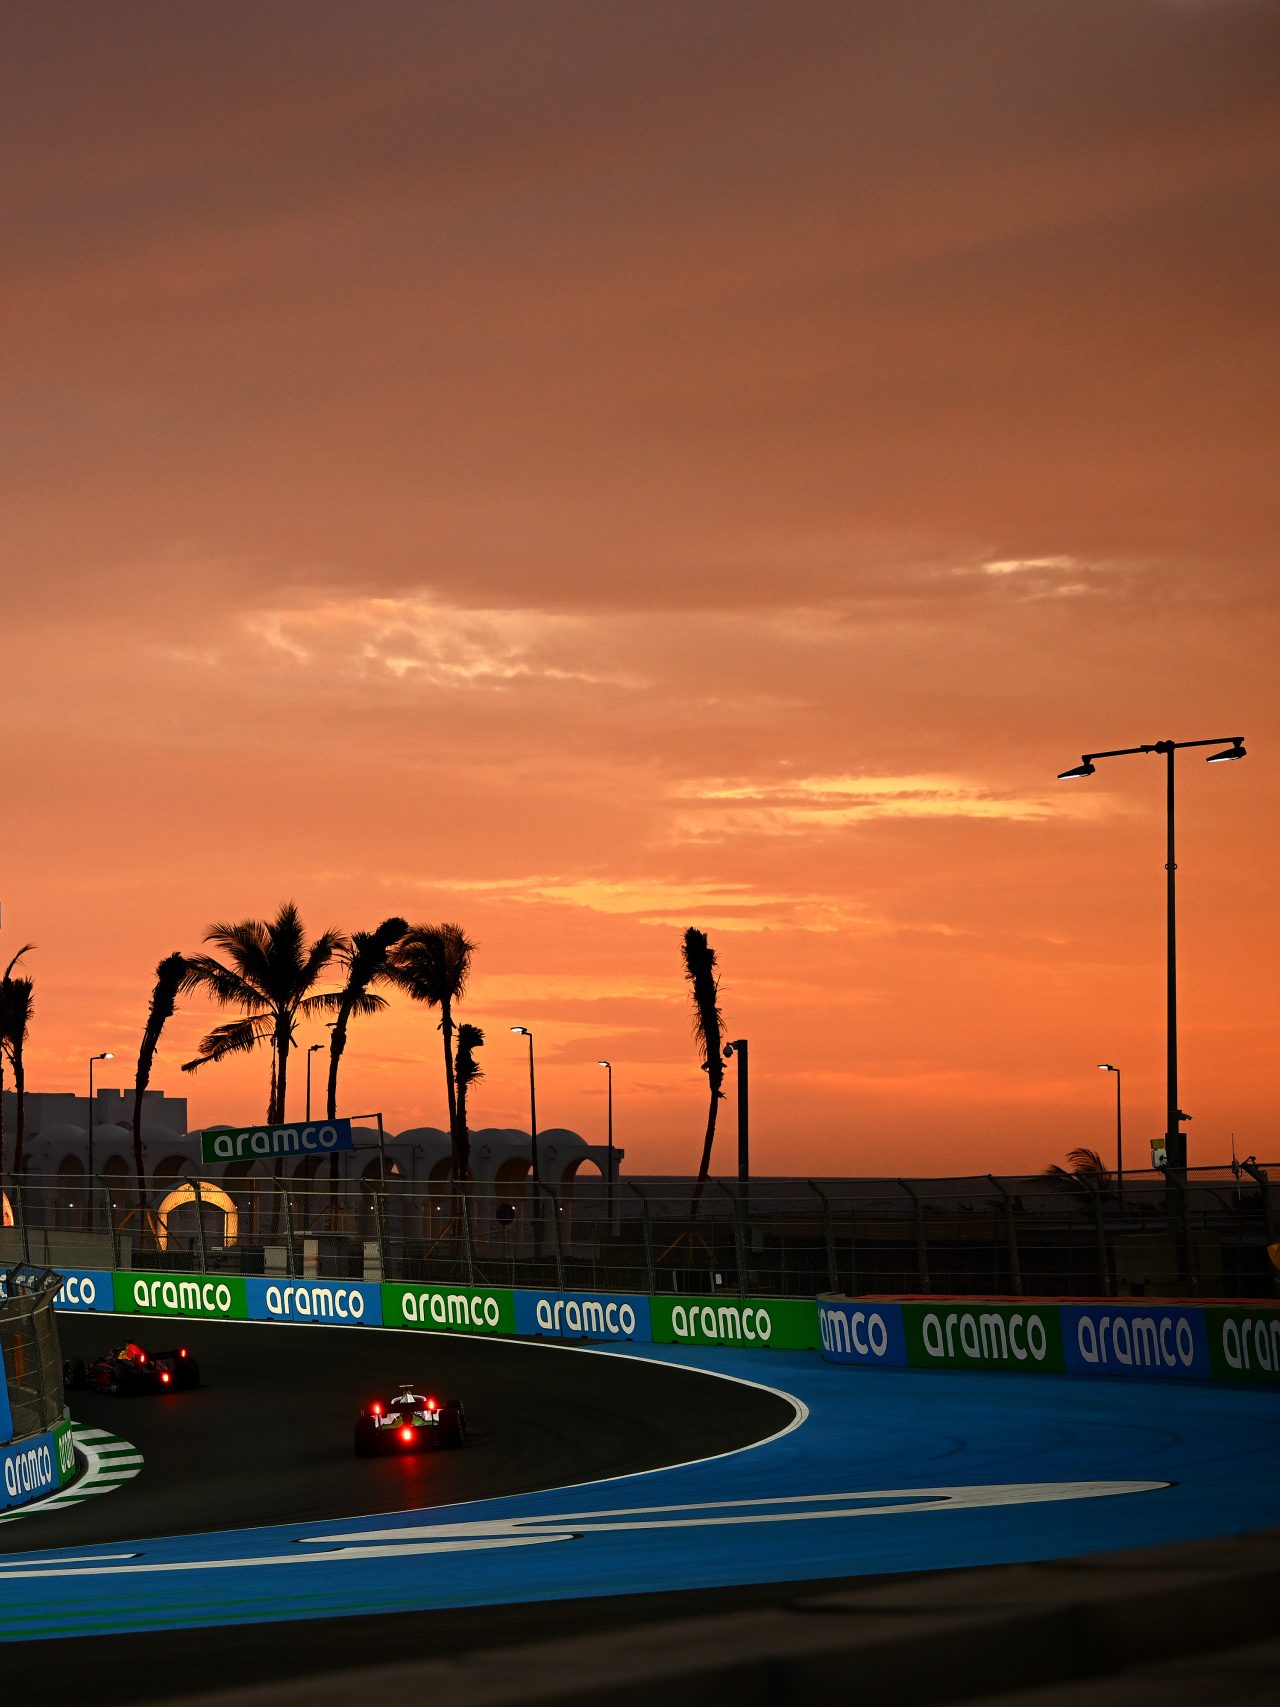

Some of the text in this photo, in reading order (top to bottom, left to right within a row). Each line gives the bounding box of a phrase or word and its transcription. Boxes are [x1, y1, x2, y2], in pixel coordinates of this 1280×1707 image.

[214, 1118, 338, 1157] aramco
[134, 1280, 231, 1312] aramco
[266, 1287, 364, 1319] aramco
[402, 1293, 500, 1327] aramco
[537, 1299, 635, 1334] aramco
[672, 1305, 772, 1341] aramco
[818, 1307, 888, 1357] amco
[922, 1313, 1047, 1361] aramco
[1078, 1316, 1194, 1368] aramco
[4, 1445, 52, 1497] aramco
